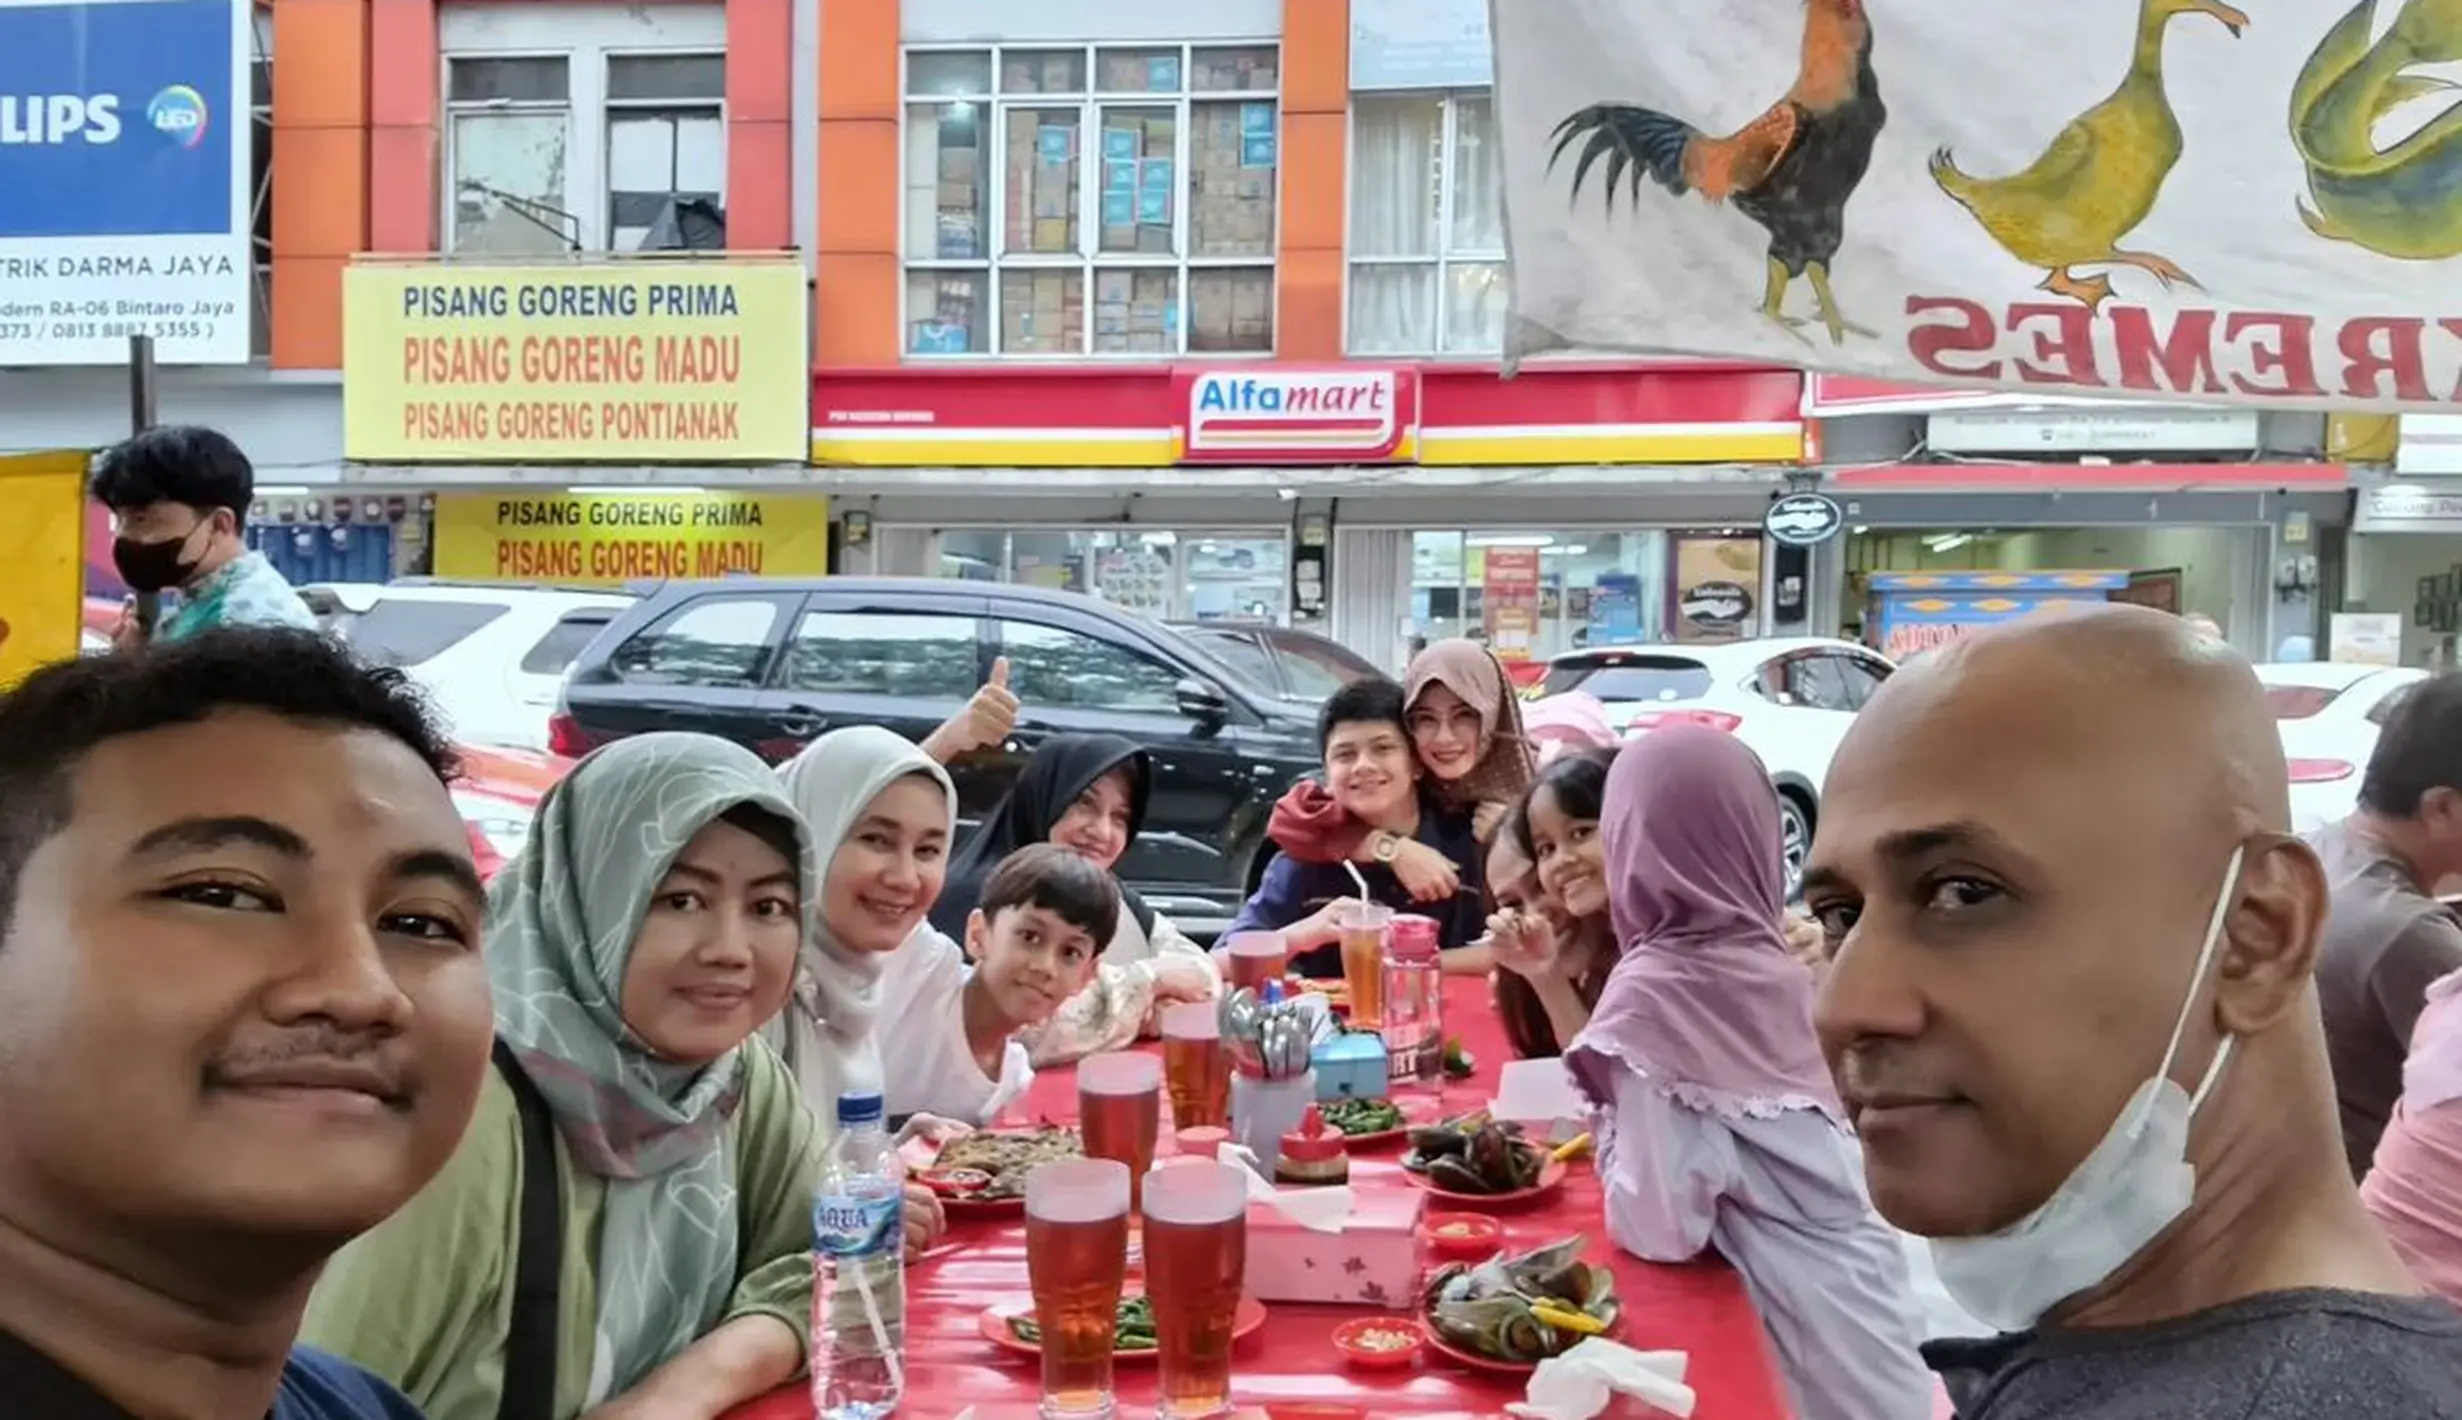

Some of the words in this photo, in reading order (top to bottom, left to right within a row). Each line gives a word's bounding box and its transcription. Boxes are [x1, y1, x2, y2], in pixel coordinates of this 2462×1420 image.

[1, 94, 121, 143] LIPS
[58, 256, 153, 277] DARMA
[164, 255, 234, 276] JAYA
[50, 300, 108, 316] RA-06
[116, 299, 184, 316] Bintaro
[191, 300, 235, 318] Jaya
[404, 286, 508, 317] PISANG
[518, 285, 637, 316] GORENG
[649, 284, 739, 316] PRIMA
[52, 321, 96, 339] 0813
[154, 321, 200, 338] 5355
[404, 336, 510, 383] PISANG
[521, 335, 643, 383] GORENG
[655, 334, 740, 383] MADU
[1199, 379, 1385, 412] Alfamart
[404, 402, 489, 440] PISANG
[497, 402, 594, 440] GORENG
[602, 402, 739, 440] PONTIANAK
[498, 502, 581, 526] PISANG
[589, 502, 684, 526] GORENG
[692, 502, 763, 526] PRIMA
[498, 540, 582, 577] PISANG
[590, 540, 688, 577] GORENG
[697, 540, 763, 577] MADU
[819, 1206, 869, 1234] AQUA
